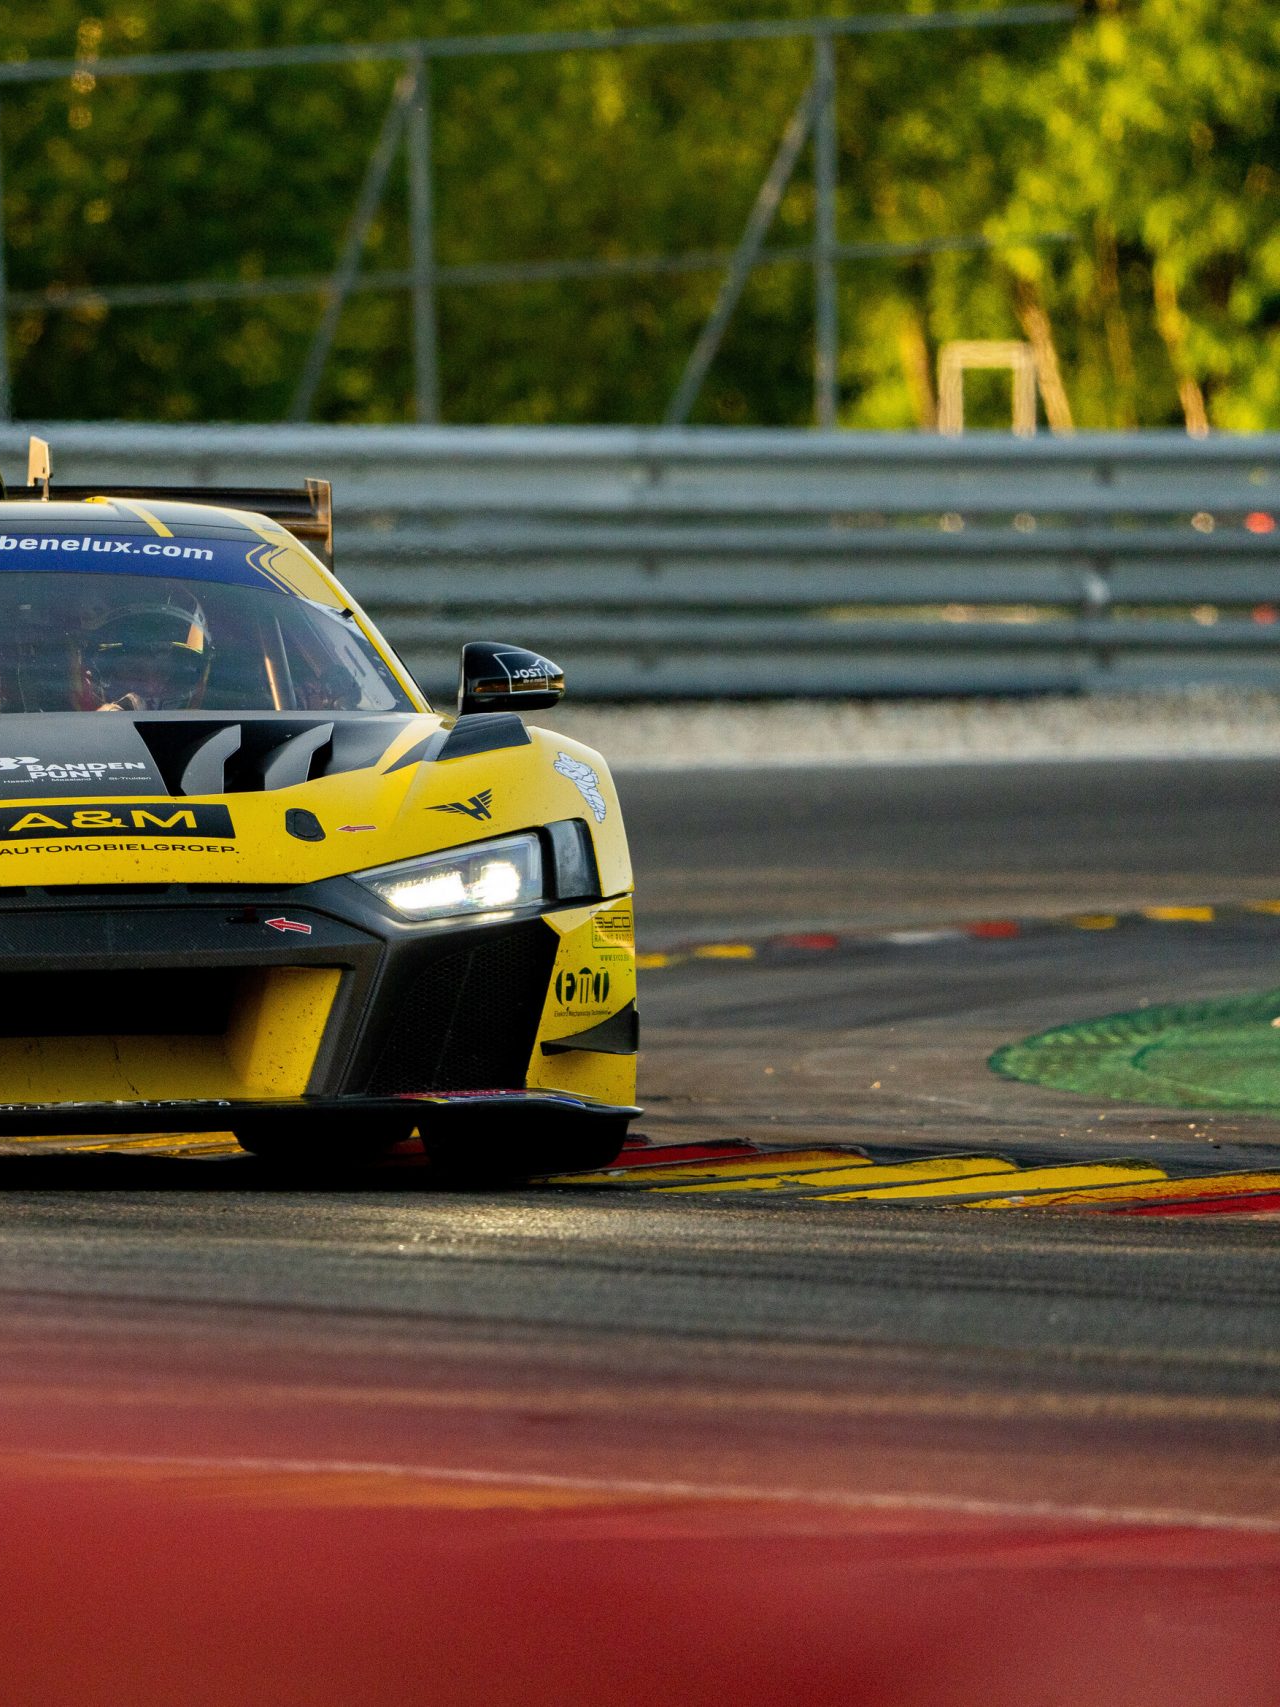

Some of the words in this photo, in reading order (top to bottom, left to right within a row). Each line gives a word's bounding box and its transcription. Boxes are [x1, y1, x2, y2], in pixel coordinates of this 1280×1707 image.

[512, 668, 541, 679] JOST
[26, 762, 146, 771] BANDEN
[29, 770, 106, 779] PUNT
[8, 810, 198, 832] A&M
[595, 917, 631, 928] SYCO
